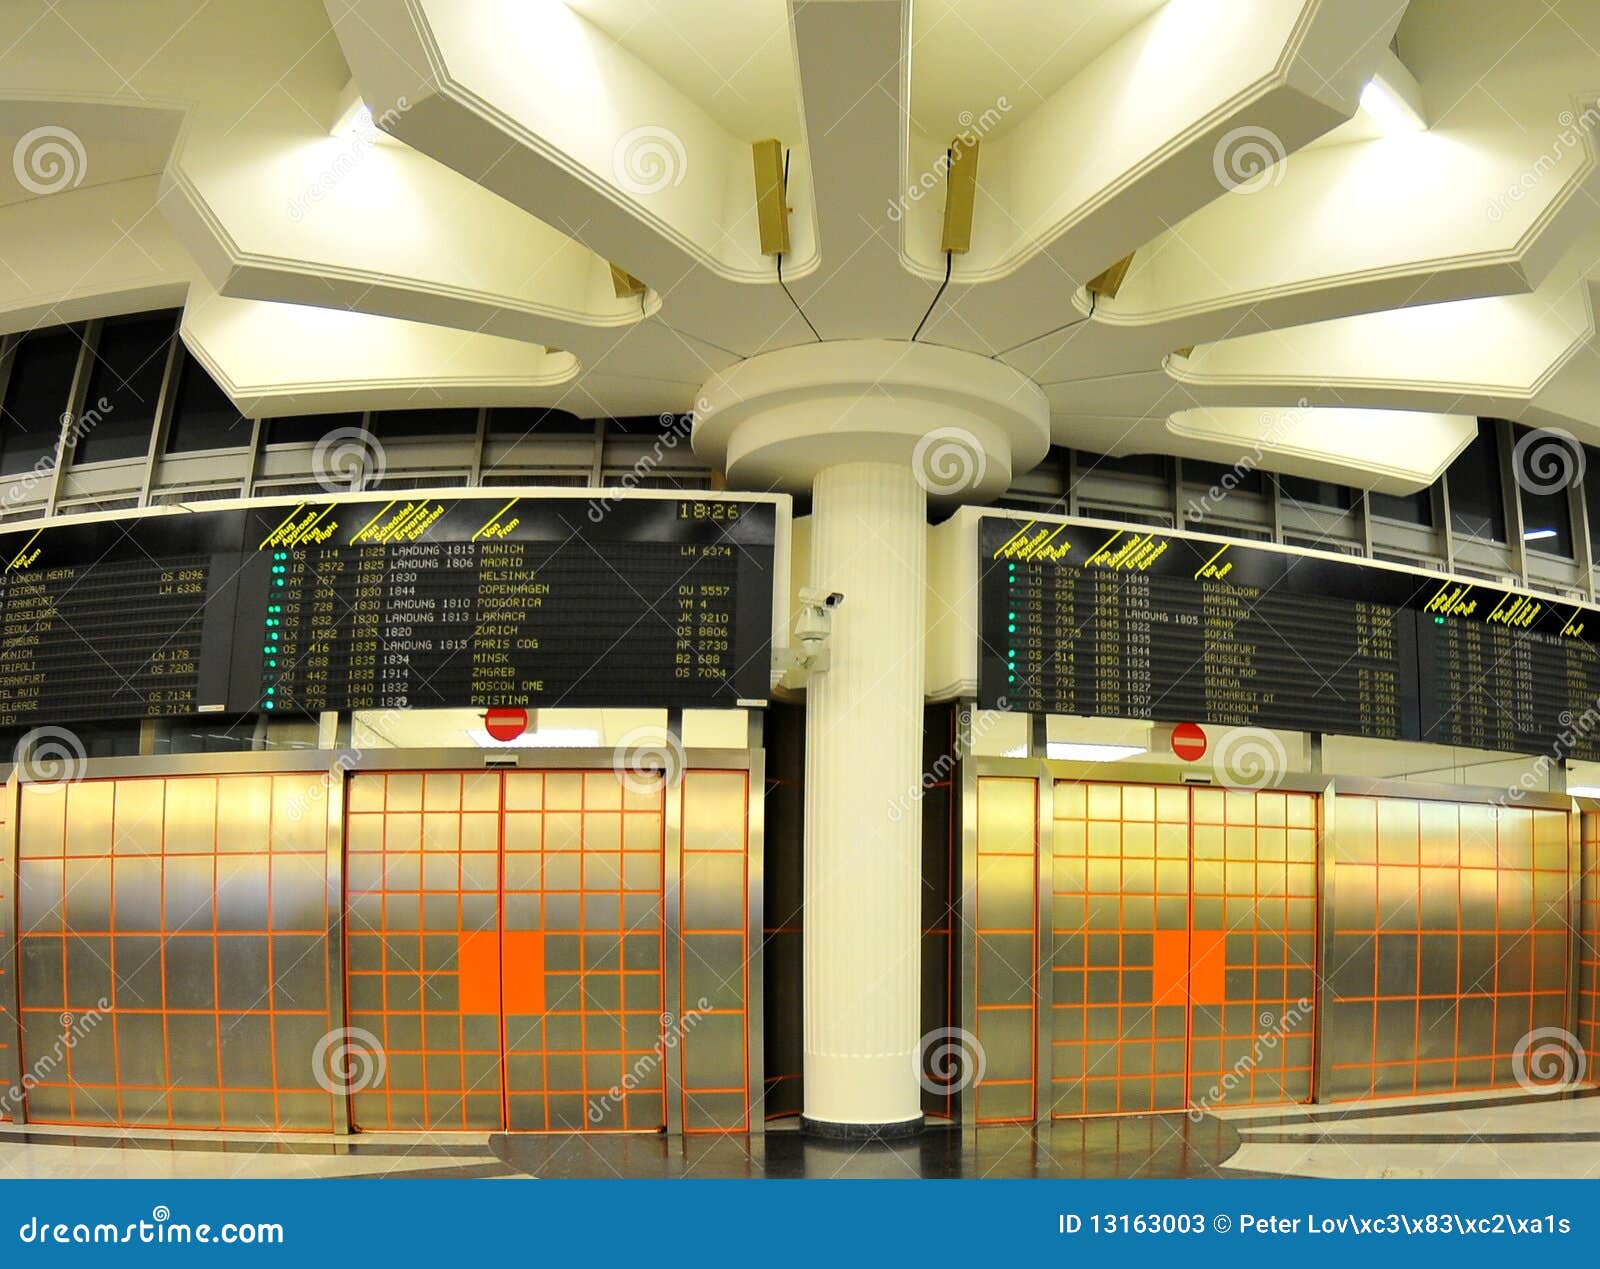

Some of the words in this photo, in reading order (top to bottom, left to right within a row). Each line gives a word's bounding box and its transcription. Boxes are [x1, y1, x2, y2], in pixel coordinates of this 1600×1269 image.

[681, 503, 739, 520] 18:26
[282, 511, 317, 546] Approach
[374, 502, 414, 541] Scheduled
[394, 508, 428, 541] Erwartet
[407, 504, 444, 541] Expected
[496, 518, 520, 539] From
[270, 522, 295, 547] Anflug
[302, 527, 320, 544] Flug
[315, 521, 338, 544] Flight
[361, 524, 379, 541] Plan
[482, 523, 500, 538] Von
[23, 548, 41, 568] From
[320, 549, 338, 559] 114
[360, 548, 386, 557] 1825
[391, 545, 440, 556] LANDUNG
[447, 545, 475, 555] 1815
[481, 545, 524, 554] MUNICH
[681, 546, 696, 556] LH
[13, 555, 27, 569] Von
[319, 562, 345, 572] 3572
[358, 560, 384, 571] 1825
[390, 559, 439, 570] LANDUNG
[446, 558, 474, 568] 1806
[480, 558, 523, 568] MADRID
[47, 569, 75, 580] HEATH
[161, 572, 173, 581] OS
[179, 570, 203, 580] 8096
[357, 574, 383, 584] 1830
[390, 573, 417, 583] 1830
[479, 571, 535, 581] HELSINKI
[288, 590, 303, 600] OS
[315, 589, 334, 599] 304
[355, 587, 382, 597] 1830
[390, 586, 416, 596] 1844
[478, 584, 550, 594] COPENHAGEN
[701, 586, 730, 596] 5557
[1202, 582, 1260, 597] DUSSELDORF
[7, 596, 54, 609] FRANKFURT
[287, 603, 301, 613] OS
[313, 602, 333, 612] 728
[354, 601, 381, 611] 1830
[387, 599, 436, 610] LANDUNG
[443, 598, 471, 609] 1810
[477, 598, 542, 608] PODGORICA
[678, 599, 693, 609] YM
[700, 599, 707, 609] 4
[5, 608, 58, 622] DUSSELDORF
[285, 616, 300, 626] OS
[311, 615, 332, 625] 832
[353, 614, 380, 624] 1830
[385, 612, 434, 623] LANDUNG
[442, 612, 469, 622] 1813
[476, 612, 526, 621] LARNACA
[678, 613, 693, 622] JK
[700, 613, 729, 623] 9210
[1125, 609, 1169, 622] LANDUNG
[283, 631, 298, 640] LX
[351, 627, 378, 638] 1835
[385, 626, 412, 637] 1820
[475, 625, 518, 635] ZURICH
[677, 626, 692, 636] OS
[699, 627, 728, 637] 8806
[1204, 629, 1234, 641] SOFIA
[282, 644, 297, 654] OS
[309, 643, 329, 653] 416
[350, 642, 377, 652] 1835
[383, 640, 433, 651] LANDUNG
[474, 640, 510, 649] PARIS
[517, 639, 539, 649] CDG
[676, 640, 691, 650] AF
[1204, 641, 1256, 655] FRANKFURT
[1, 650, 33, 660] MUNICH
[281, 658, 296, 668] OS
[349, 656, 376, 666] 1835
[383, 654, 409, 665] 1834
[473, 653, 509, 663] MINSK
[698, 655, 720, 664] 688
[1, 662, 36, 673] TRIPOLI
[306, 671, 328, 681] 442
[348, 669, 375, 680] 1835
[382, 668, 409, 679] 1914
[472, 667, 516, 677] ZAGREB
[675, 668, 690, 678] OS
[698, 668, 727, 678] 7054
[0, 674, 46, 686] FRANKFURT
[17, 688, 39, 698] AVIV
[305, 684, 327, 695] 602
[347, 683, 374, 694] 1840
[382, 682, 409, 693] 1832
[472, 681, 515, 691] MOSCOW
[279, 700, 293, 710] OS
[346, 697, 374, 708] 1840
[471, 695, 529, 705] PRISTINA
[1127, 694, 1151, 705] 1907
[1206, 700, 1259, 714] STOCKHOLM
